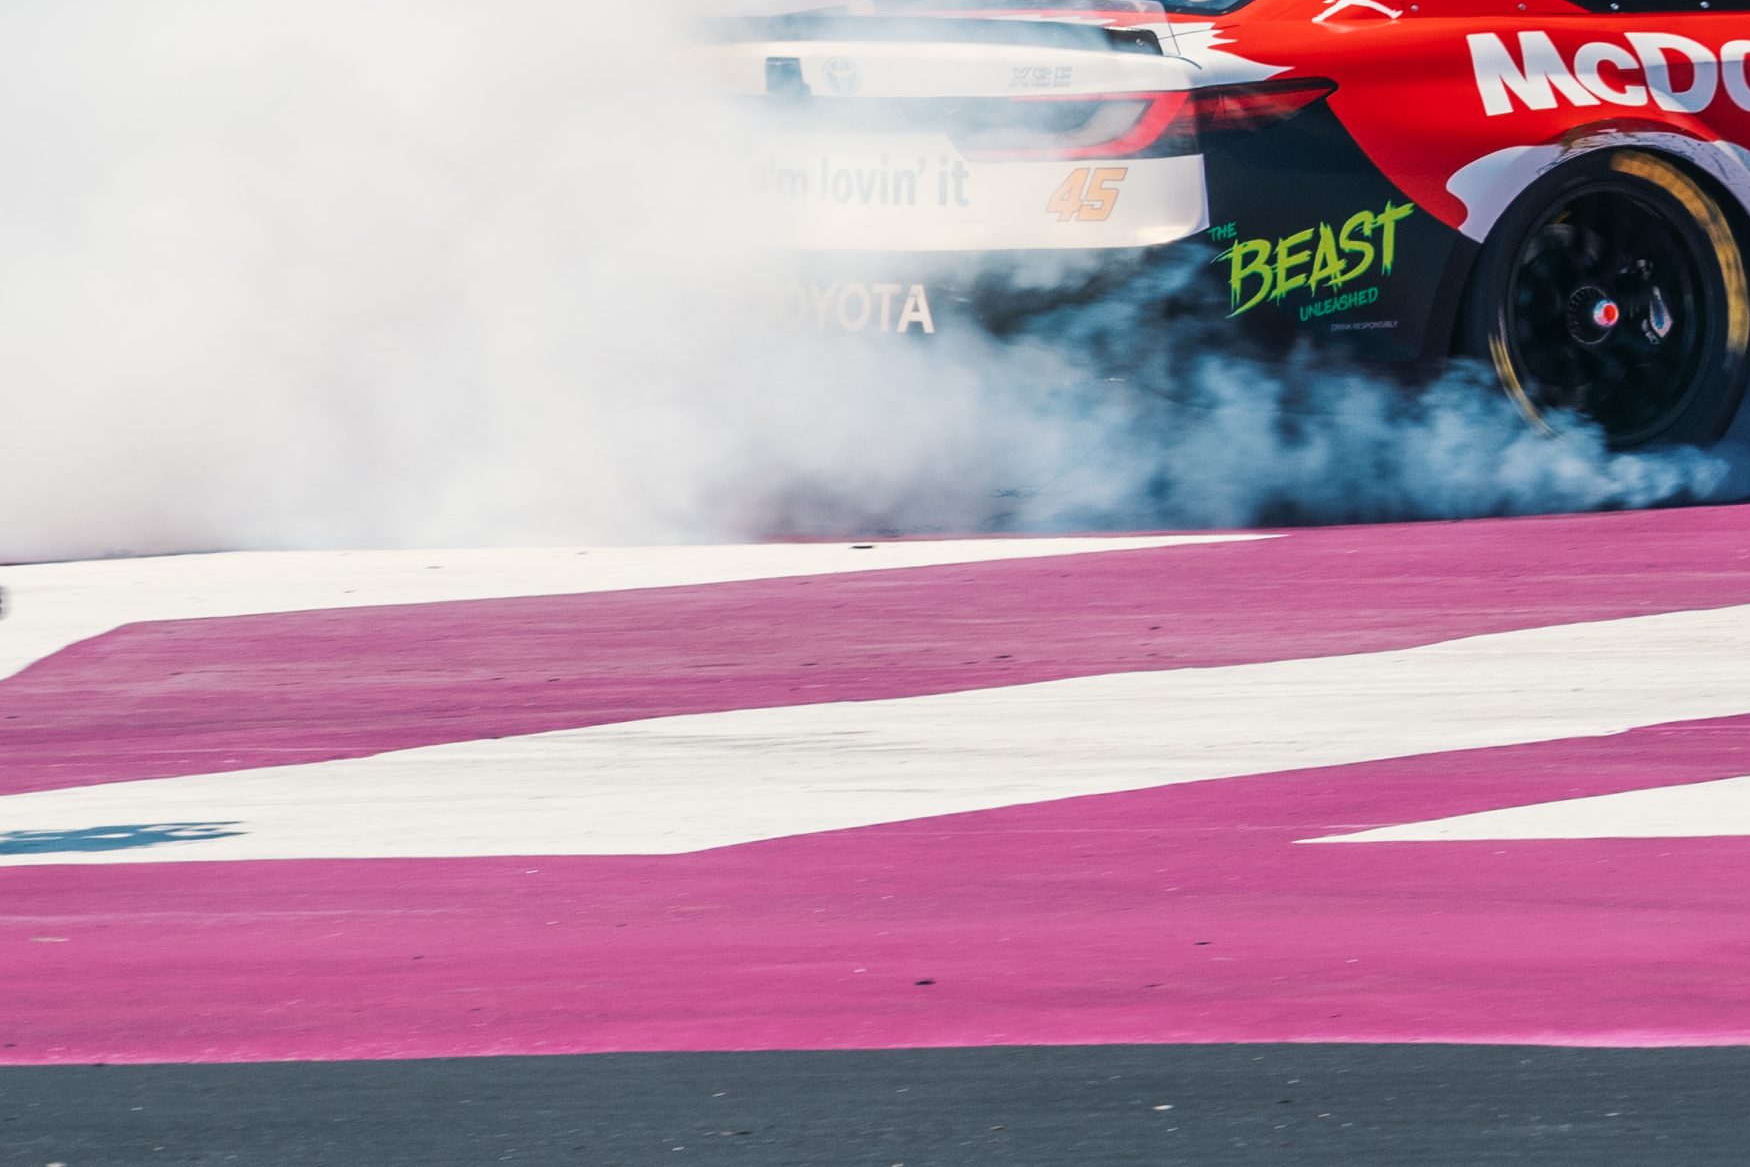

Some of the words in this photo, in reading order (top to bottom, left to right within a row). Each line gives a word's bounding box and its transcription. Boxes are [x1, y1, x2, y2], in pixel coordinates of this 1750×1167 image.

[1009, 66, 1073, 89] XSE
[821, 154, 927, 206] lovin'
[937, 154, 970, 207] it
[1045, 166, 1129, 223] 45
[1207, 221, 1237, 242] THE
[1209, 199, 1415, 320] BEAST
[1299, 286, 1379, 322] UNLEASHED
